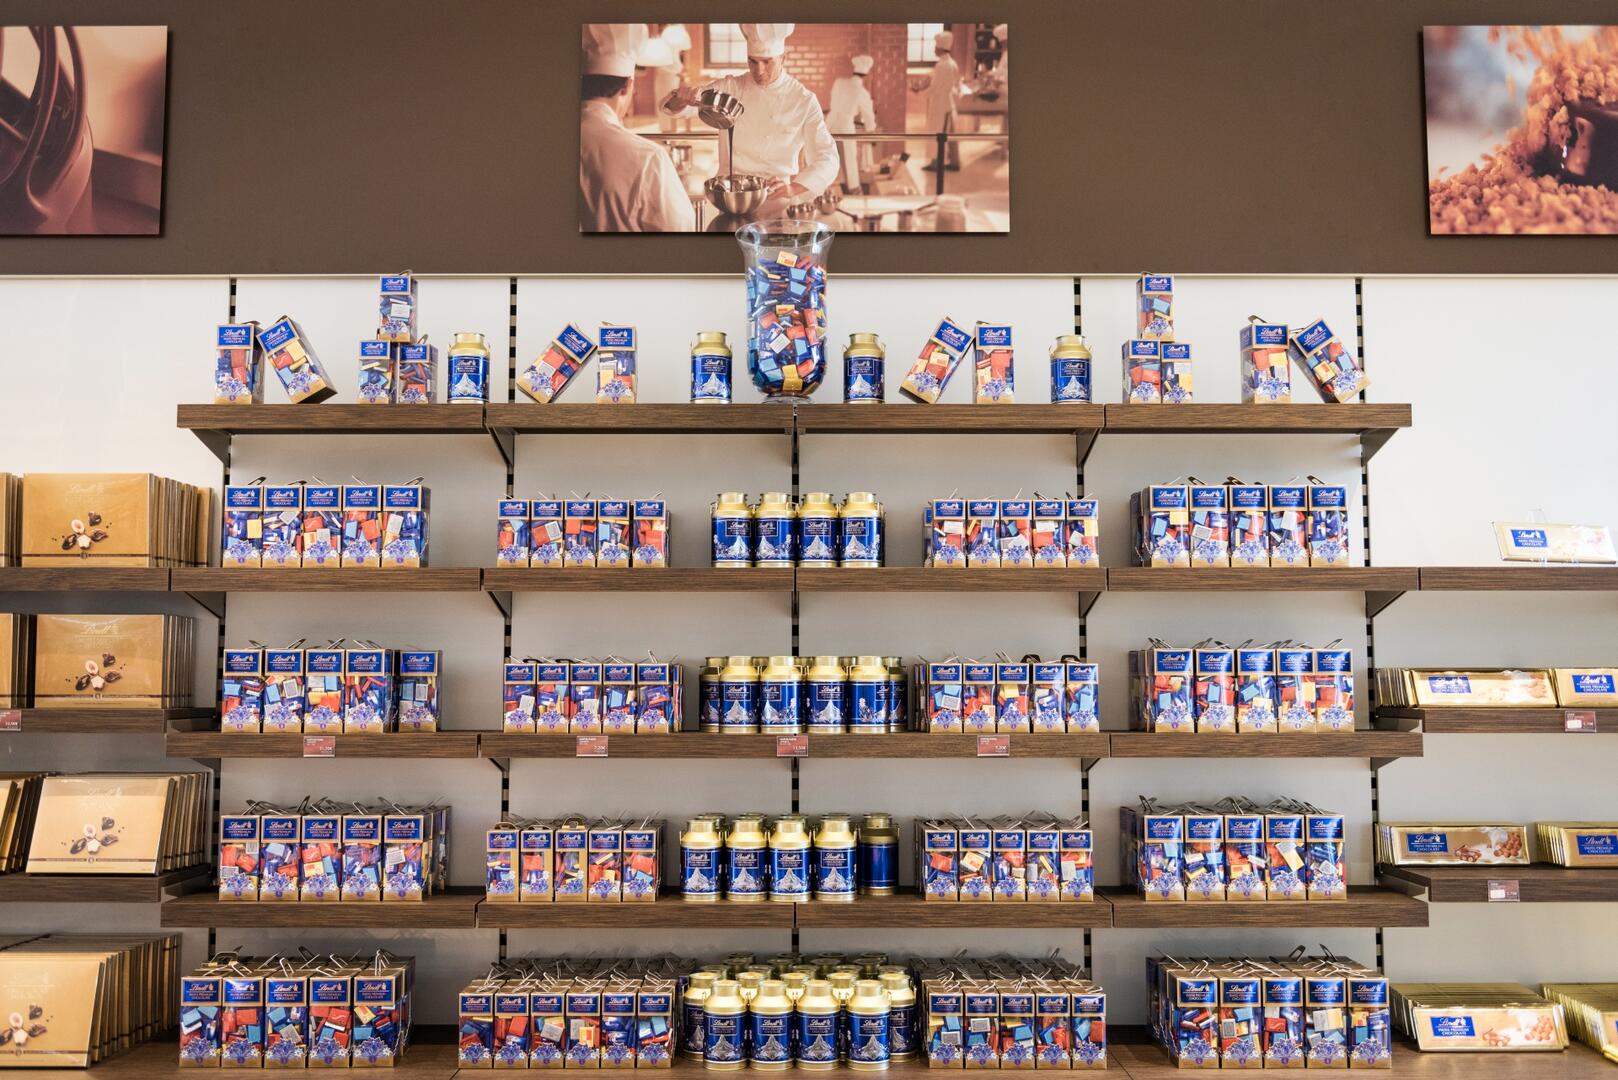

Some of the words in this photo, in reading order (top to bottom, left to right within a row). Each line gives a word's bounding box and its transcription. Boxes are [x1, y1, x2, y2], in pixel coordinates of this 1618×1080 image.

[1581, 675, 1601, 683] Lindt
[391, 821, 411, 829] Lindt
[1233, 821, 1253, 829] Lindt
[1413, 835, 1435, 843] Lindt
[1584, 837, 1606, 845] Lindt
[273, 984, 295, 992] Lindt
[361, 983, 383, 991] Lindt
[1438, 1018, 1460, 1026] Lindt
